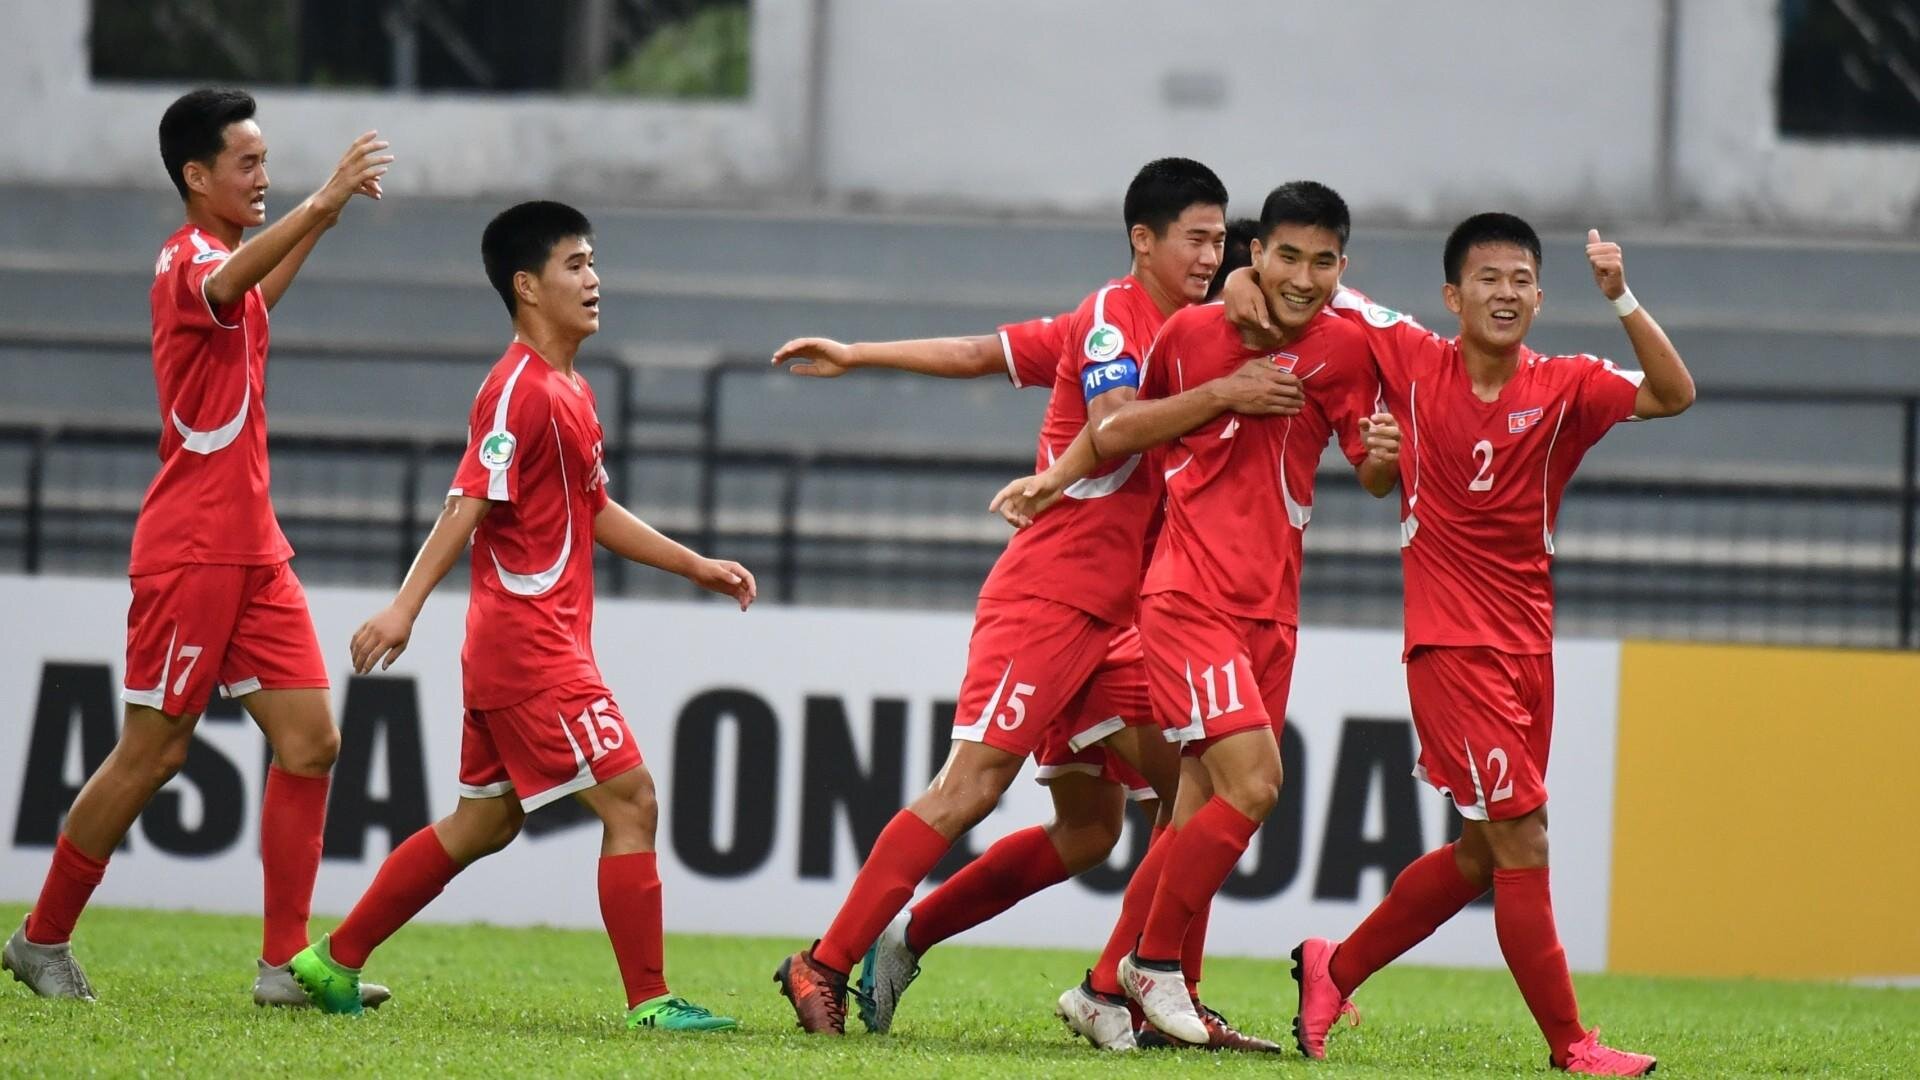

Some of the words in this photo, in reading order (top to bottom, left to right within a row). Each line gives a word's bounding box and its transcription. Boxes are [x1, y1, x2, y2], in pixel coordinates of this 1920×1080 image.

[1467, 439, 1495, 492] 2
[173, 645, 203, 696] 7
[1201, 658, 1244, 720] 11
[577, 697, 624, 762] 15
[996, 682, 1036, 731] 5
[13, 661, 432, 862] ASA
[1486, 747, 1513, 803] 2
